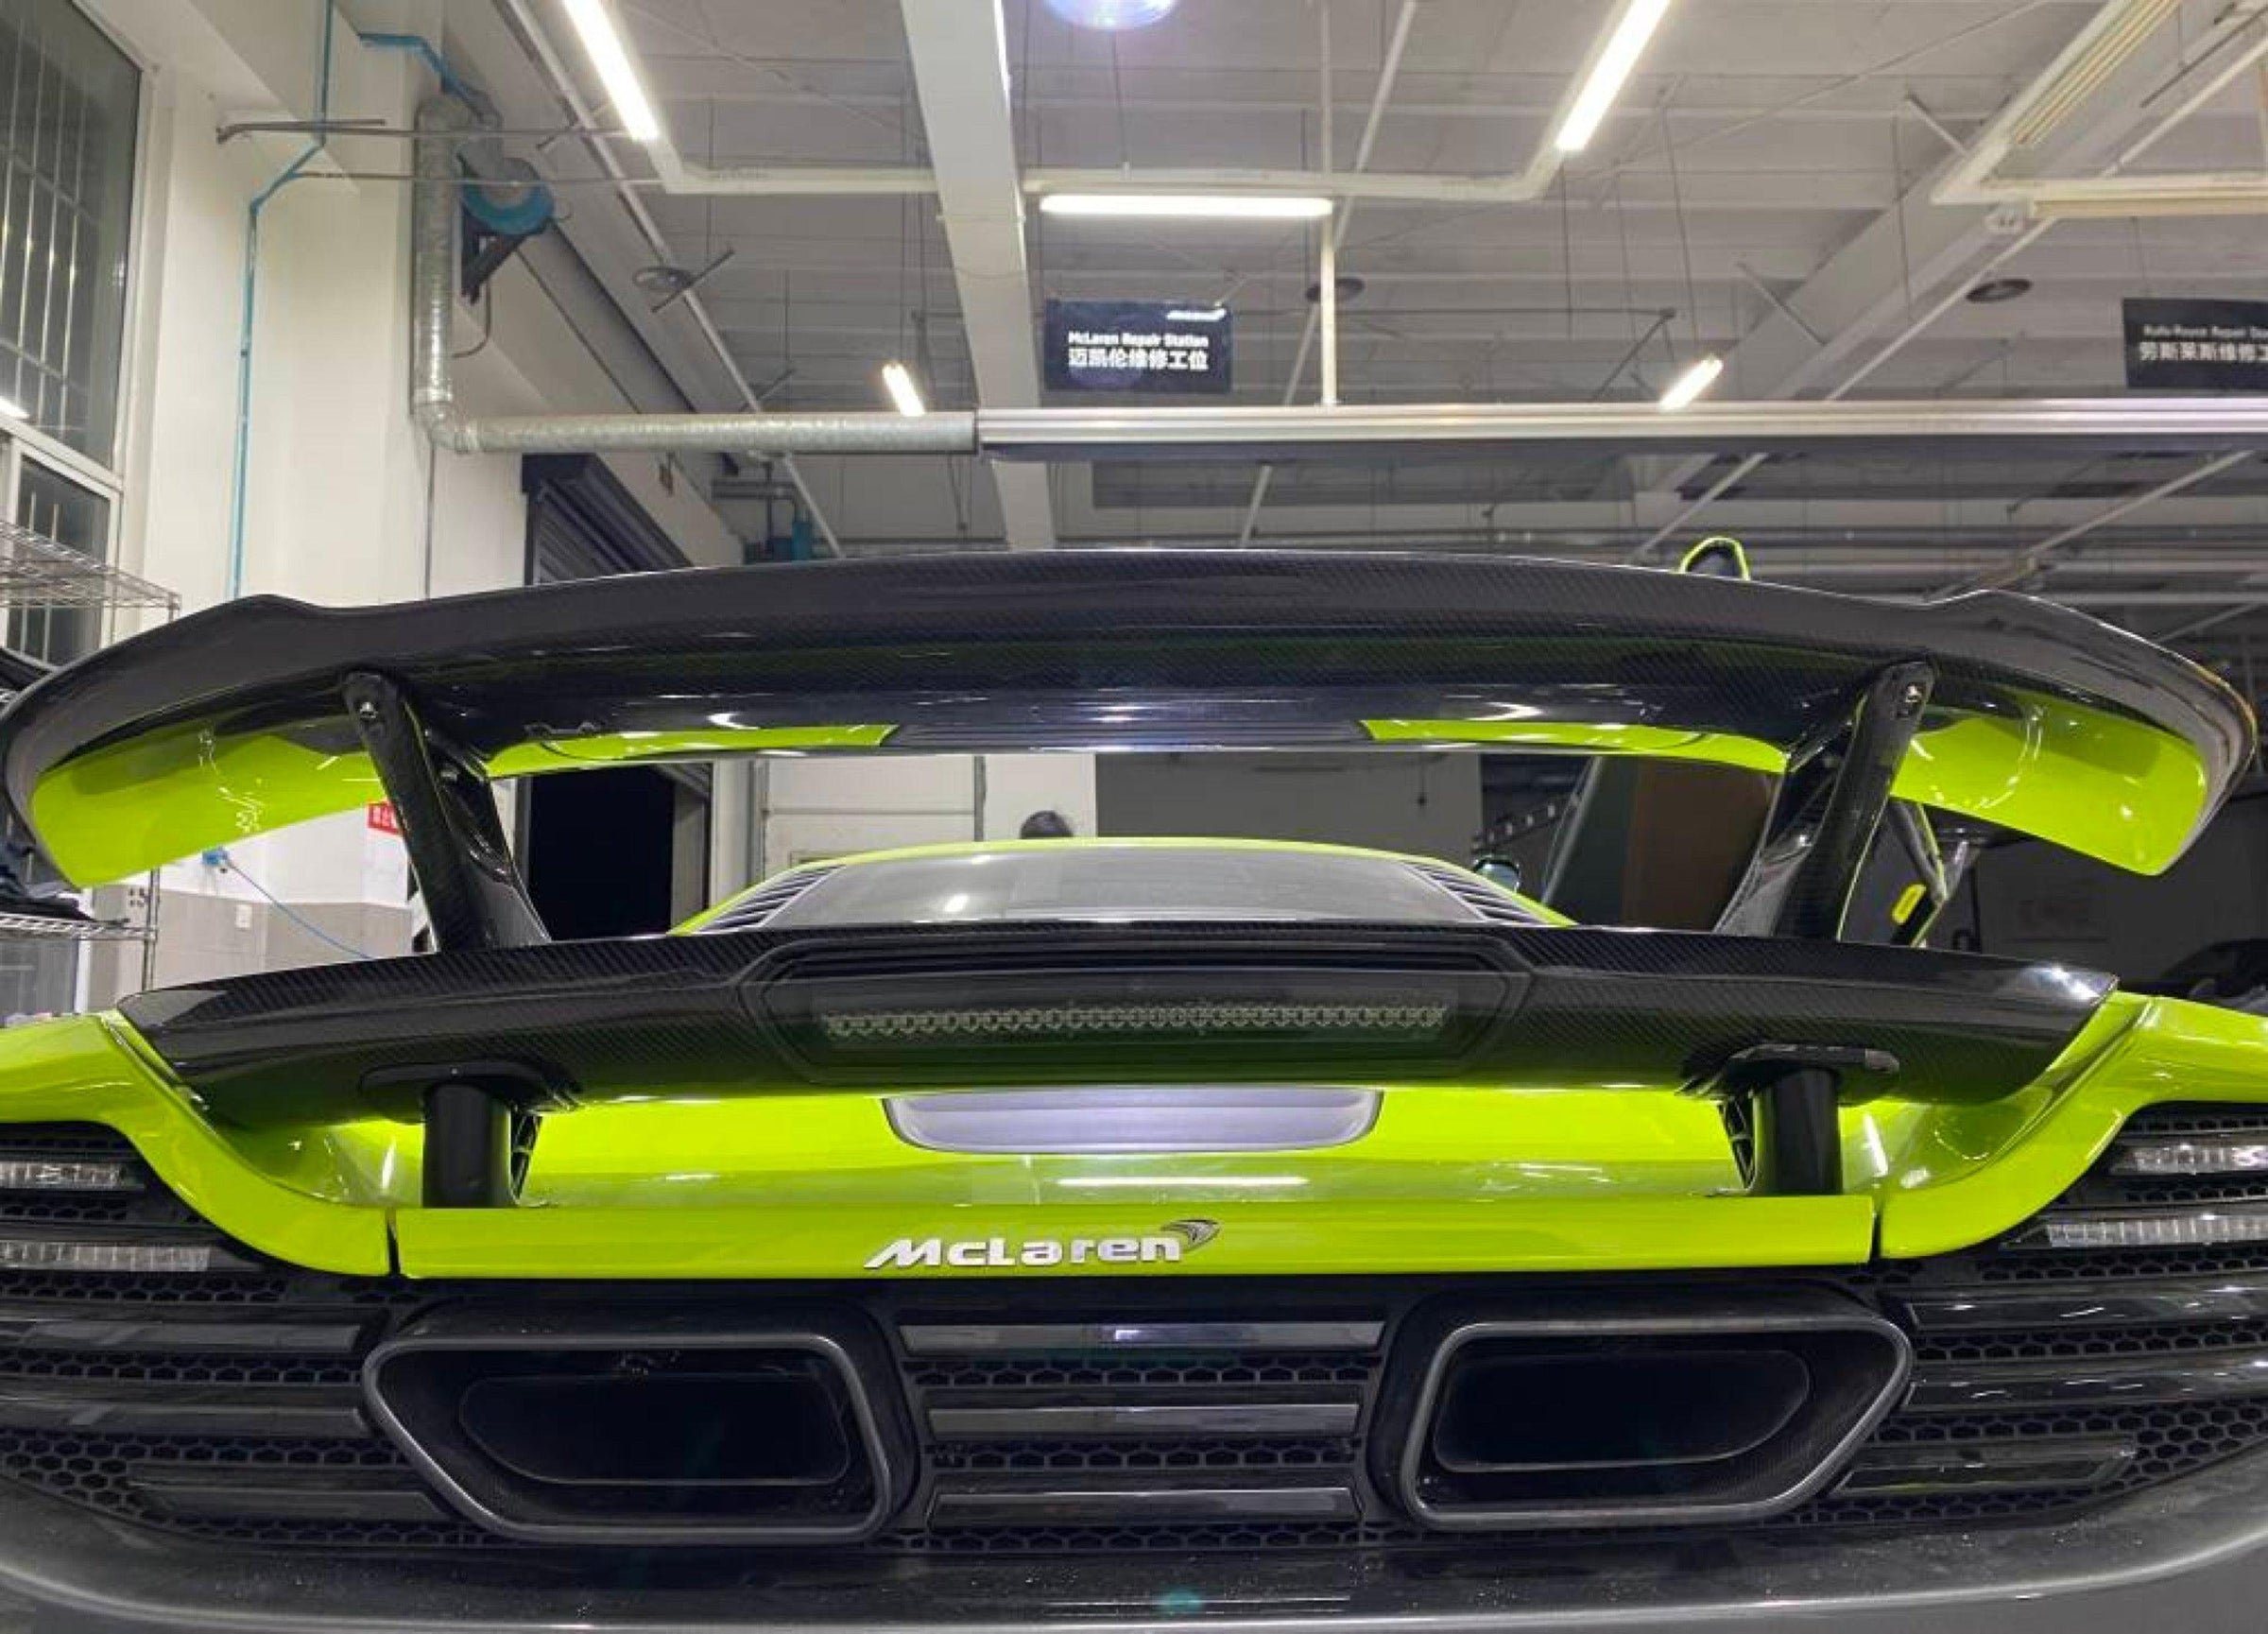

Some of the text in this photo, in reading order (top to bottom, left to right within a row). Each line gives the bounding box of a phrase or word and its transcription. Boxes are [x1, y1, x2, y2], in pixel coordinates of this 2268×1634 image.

[1068, 331, 1209, 347] McLaren Repair Station
[1068, 347, 1210, 370] 迈凯伦维修工位
[864, 1237, 1181, 1268] McLaren
